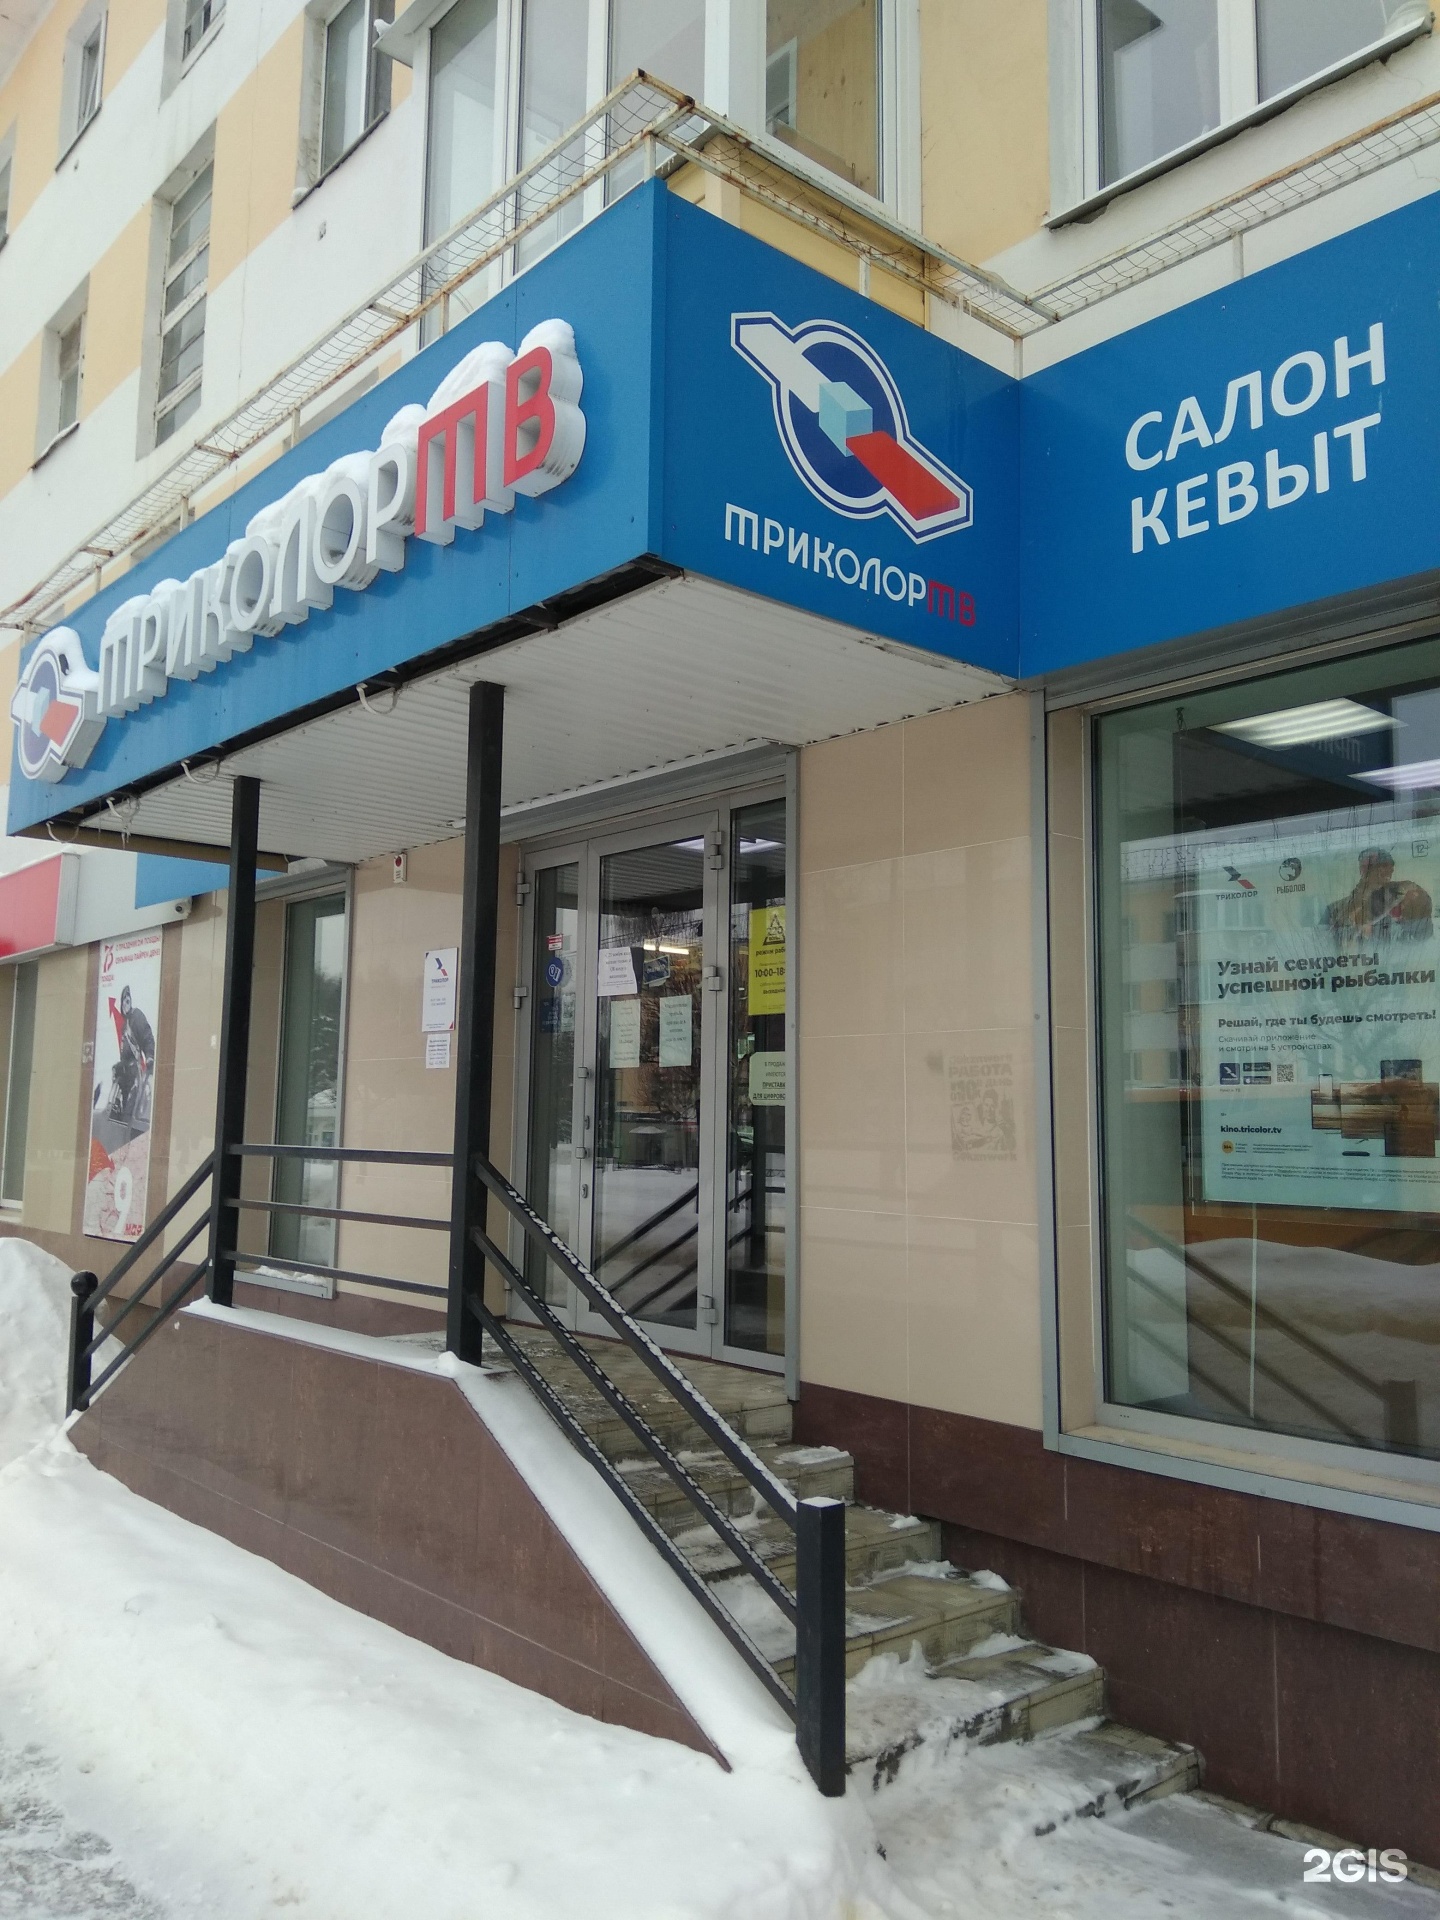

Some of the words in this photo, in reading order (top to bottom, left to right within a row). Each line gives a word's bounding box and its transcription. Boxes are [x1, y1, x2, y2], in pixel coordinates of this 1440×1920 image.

[1125, 322, 1386, 471] САЛОН
[1131, 412, 1381, 554] КЕВЫТ
[1276, 883, 1306, 895] РЫБОЛОВ
[1215, 890, 1258, 901] ТРИКОЛОР
[775, 947, 785, 955] раб
[1217, 956, 1279, 976] Узнай
[1284, 953, 1379, 973] секреты
[1217, 973, 1325, 999] успешной
[1331, 969, 1436, 992] рыбалки
[1218, 1016, 1262, 1028] Решай,
[1265, 1018, 1286, 1027] где
[1289, 1017, 1307, 1025] ты
[1310, 1013, 1362, 1026] будешь
[1366, 1010, 1436, 1023] смотреть!
[1218, 1035, 1258, 1043] Скачивай
[1260, 1033, 1316, 1042] приложение
[1278, 1043, 1332, 1052] устройствах
[1220, 1125, 1282, 1134] kino.tricolor.tv
